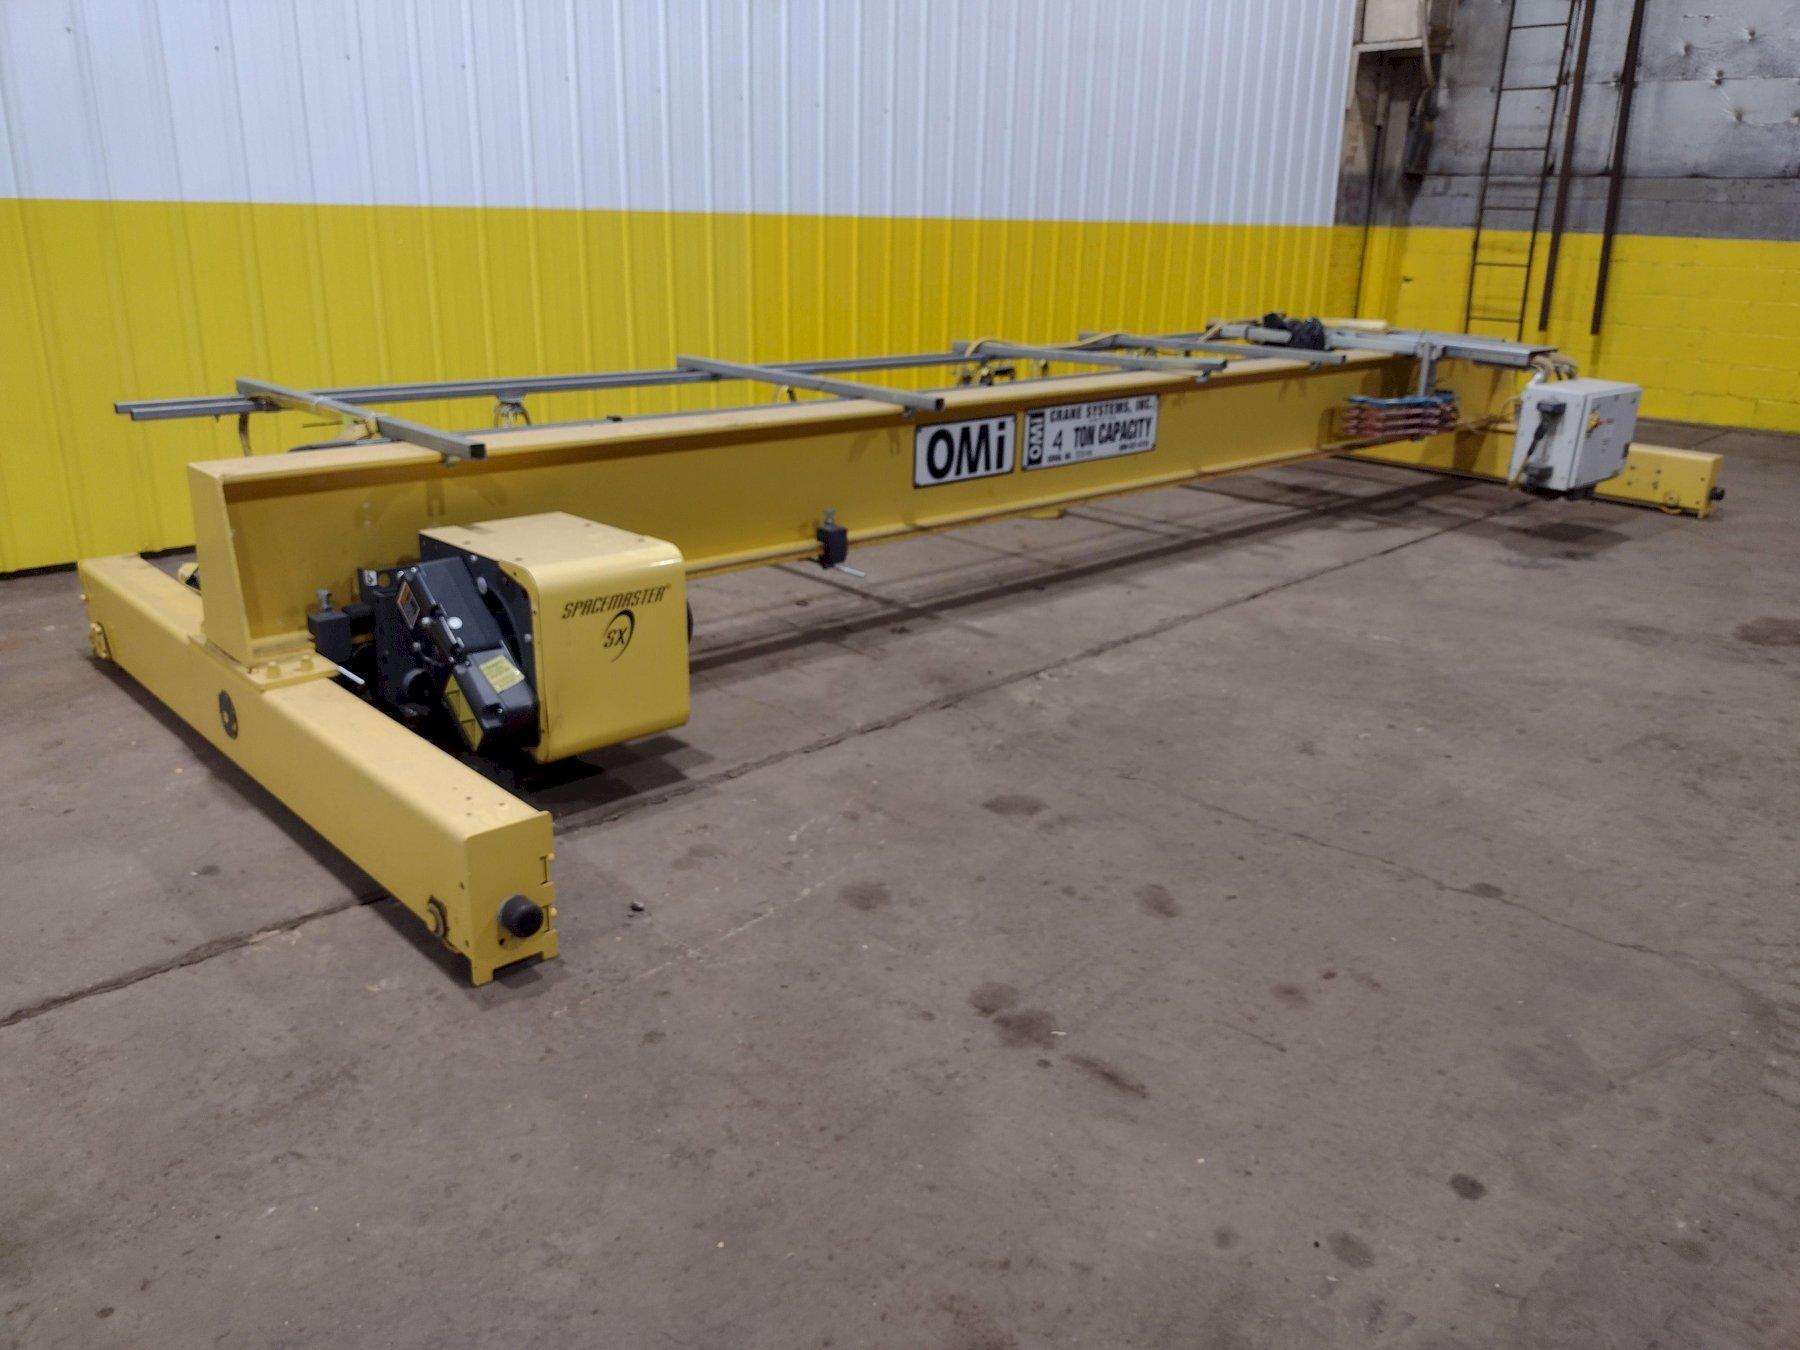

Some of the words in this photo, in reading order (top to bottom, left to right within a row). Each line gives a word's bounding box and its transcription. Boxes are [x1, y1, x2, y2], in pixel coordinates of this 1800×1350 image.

[1050, 406, 1081, 422] CRANE
[1052, 429, 1063, 451] 4
[1074, 424, 1096, 448] TON
[1098, 417, 1152, 444] CAPACITY
[603, 627, 628, 648] SX
